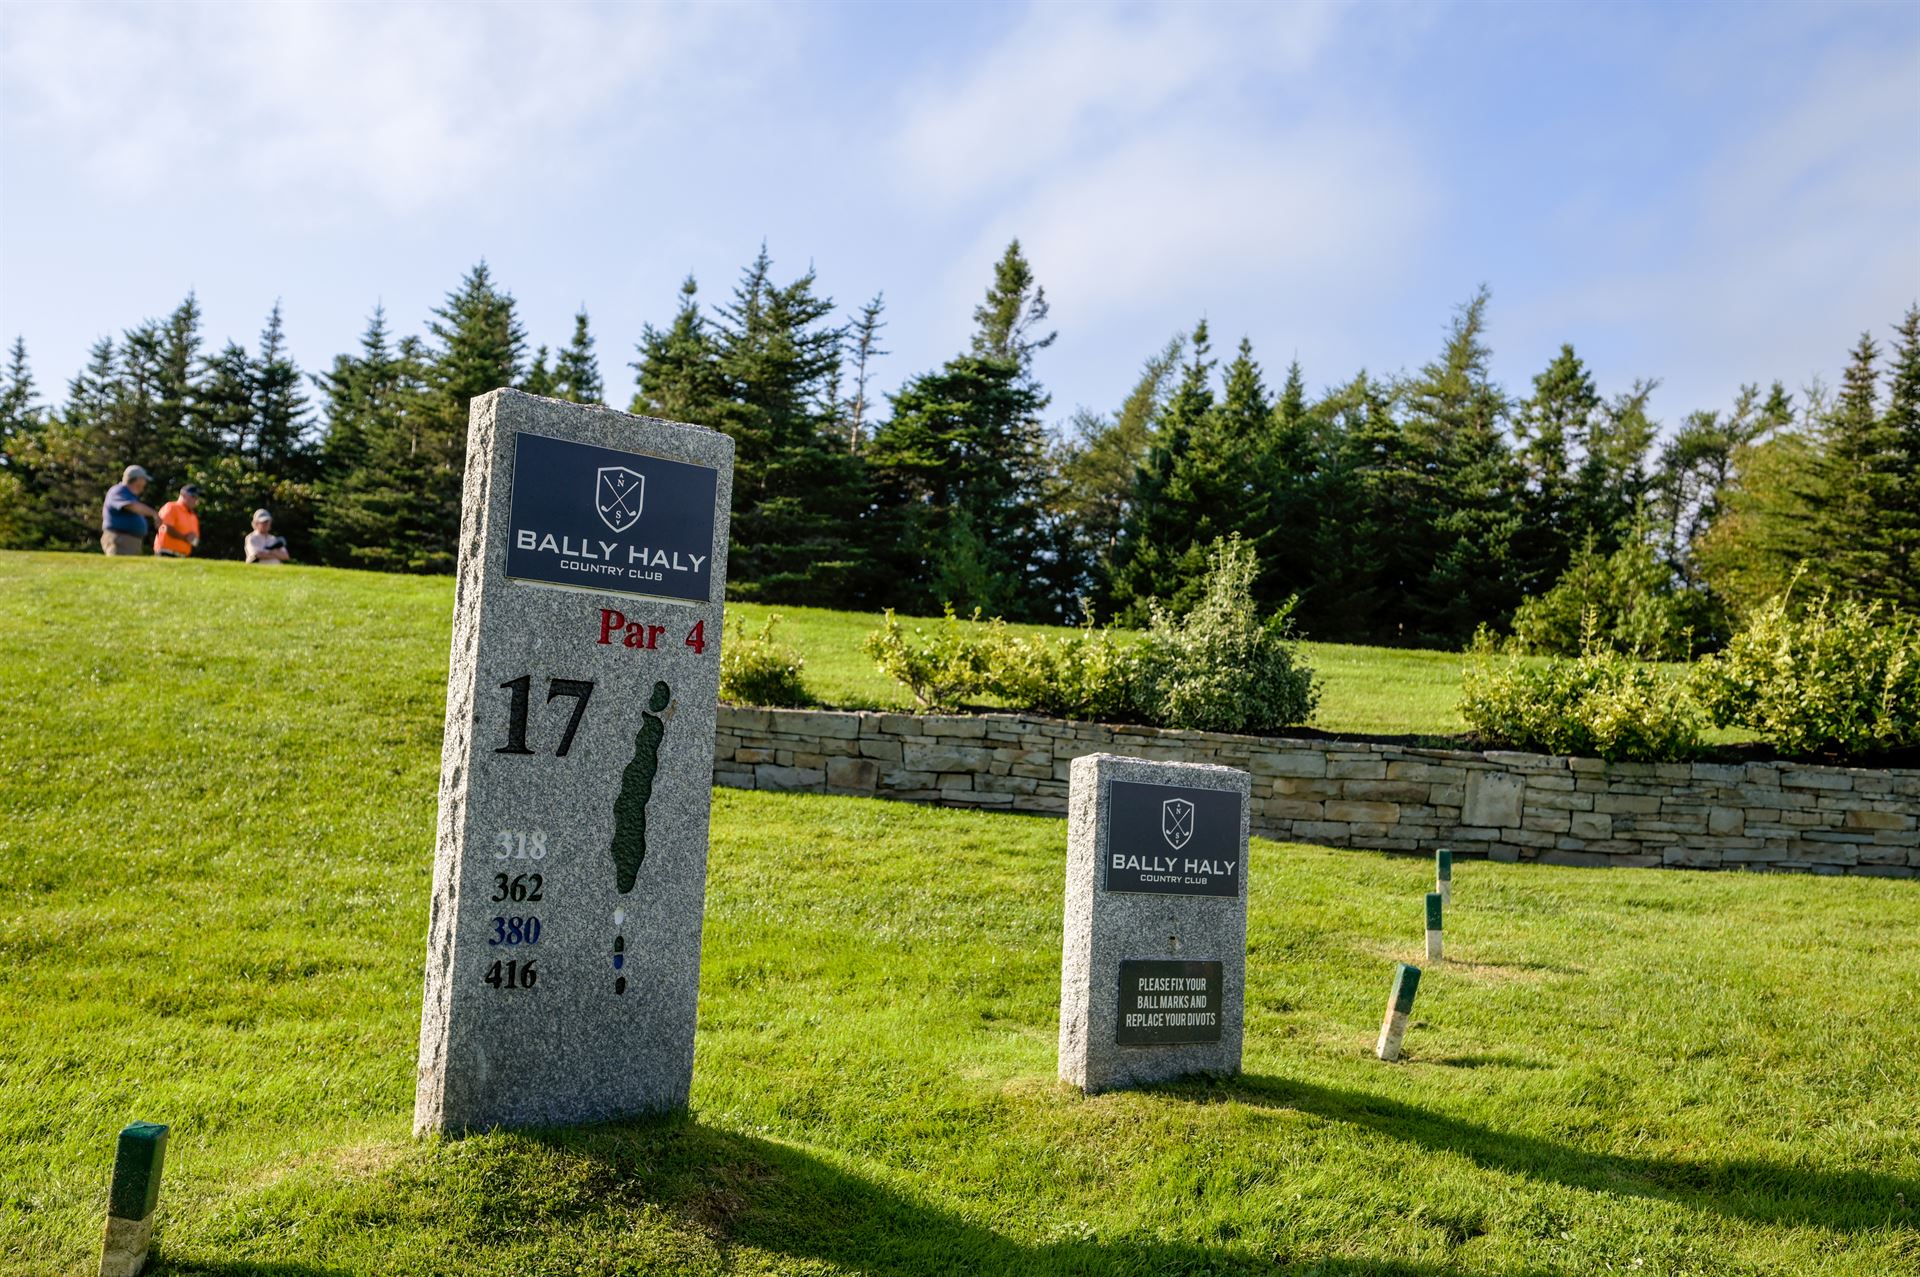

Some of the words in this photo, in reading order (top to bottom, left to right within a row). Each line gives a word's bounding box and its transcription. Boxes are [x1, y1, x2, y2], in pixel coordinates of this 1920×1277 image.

[517, 529, 618, 561] BALLY
[628, 545, 706, 573] HALY
[560, 560, 625, 576] COUNTRY
[628, 569, 663, 581] CLUB
[596, 608, 665, 650] Par
[685, 619, 705, 654] 4
[494, 674, 594, 757] 17
[496, 830, 547, 860] 318
[1112, 853, 1178, 872] BALLY
[1184, 858, 1236, 876] HALY
[491, 873, 543, 902] 362
[1140, 874, 1182, 884] COUNTRY
[1184, 877, 1208, 885] CLUB
[488, 915, 541, 946] 380
[484, 959, 537, 990] 416
[1138, 978, 1170, 991] PLEASE
[1171, 978, 1184, 991] FIX
[1185, 978, 1207, 991] YOUR
[1137, 995, 1159, 1009] BALL
[1159, 995, 1189, 1009] MARKS
[1190, 995, 1207, 1008] AND
[1126, 1013, 1164, 1027] REPLACE
[1165, 1013, 1186, 1026] YOUR
[1187, 1012, 1216, 1026] DIVOTS
